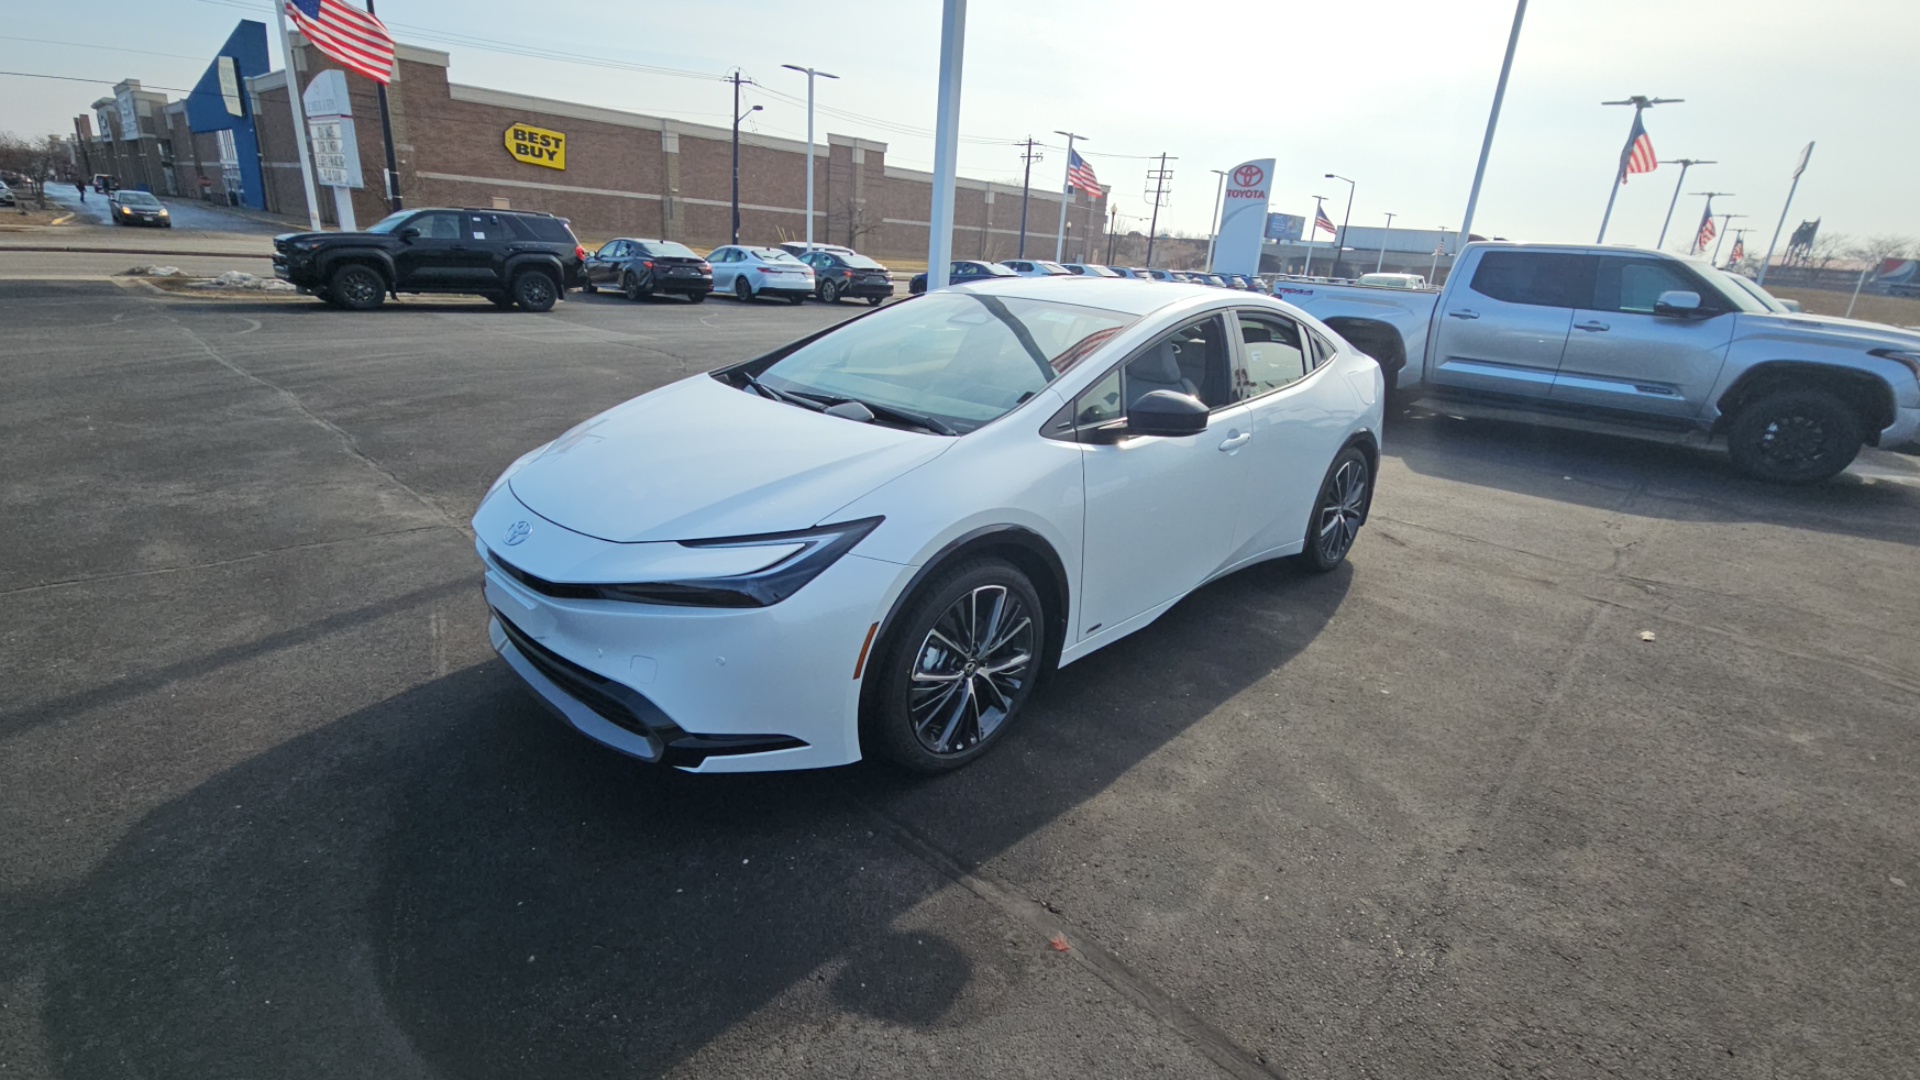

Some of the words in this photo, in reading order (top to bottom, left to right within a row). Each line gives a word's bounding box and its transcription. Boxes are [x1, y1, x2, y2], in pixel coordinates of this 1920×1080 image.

[513, 128, 563, 149] BEST
[516, 142, 558, 161] BUY
[1226, 189, 1266, 199] TOYOTA
